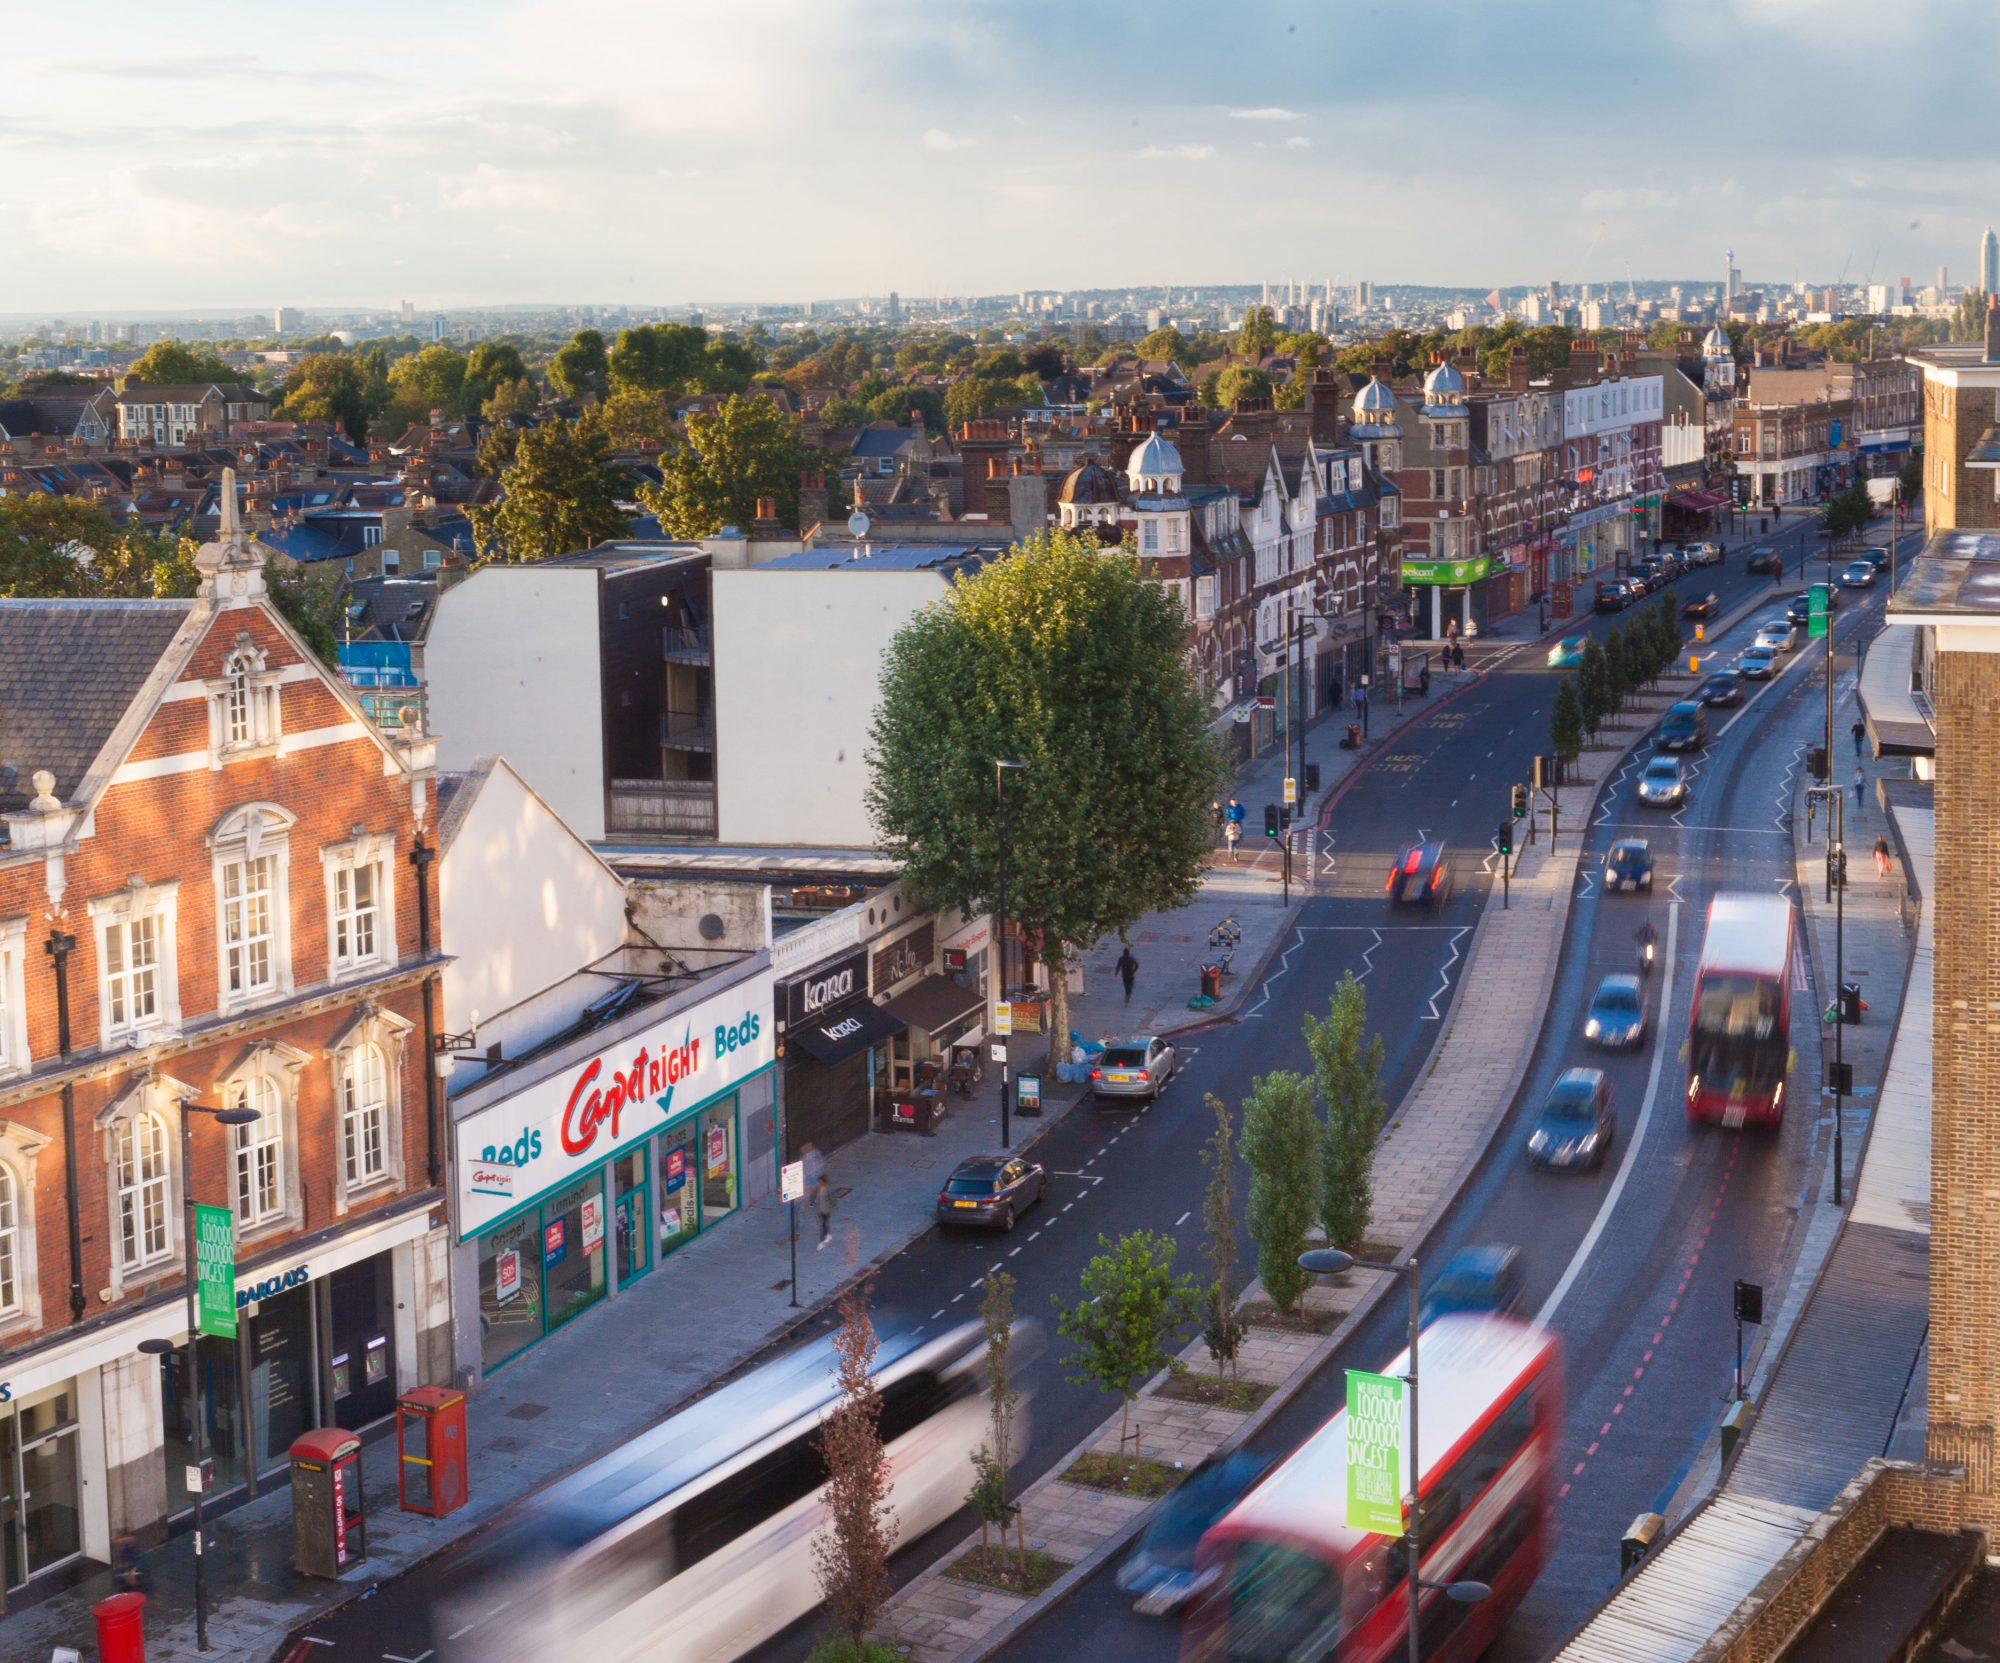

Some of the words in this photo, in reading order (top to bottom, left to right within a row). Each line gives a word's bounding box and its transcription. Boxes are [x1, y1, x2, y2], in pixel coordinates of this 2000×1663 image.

[715, 1011, 760, 1060] Beds
[236, 1264, 309, 1308] BARCLAYS
[1347, 1441, 1388, 1470] ONGEST
